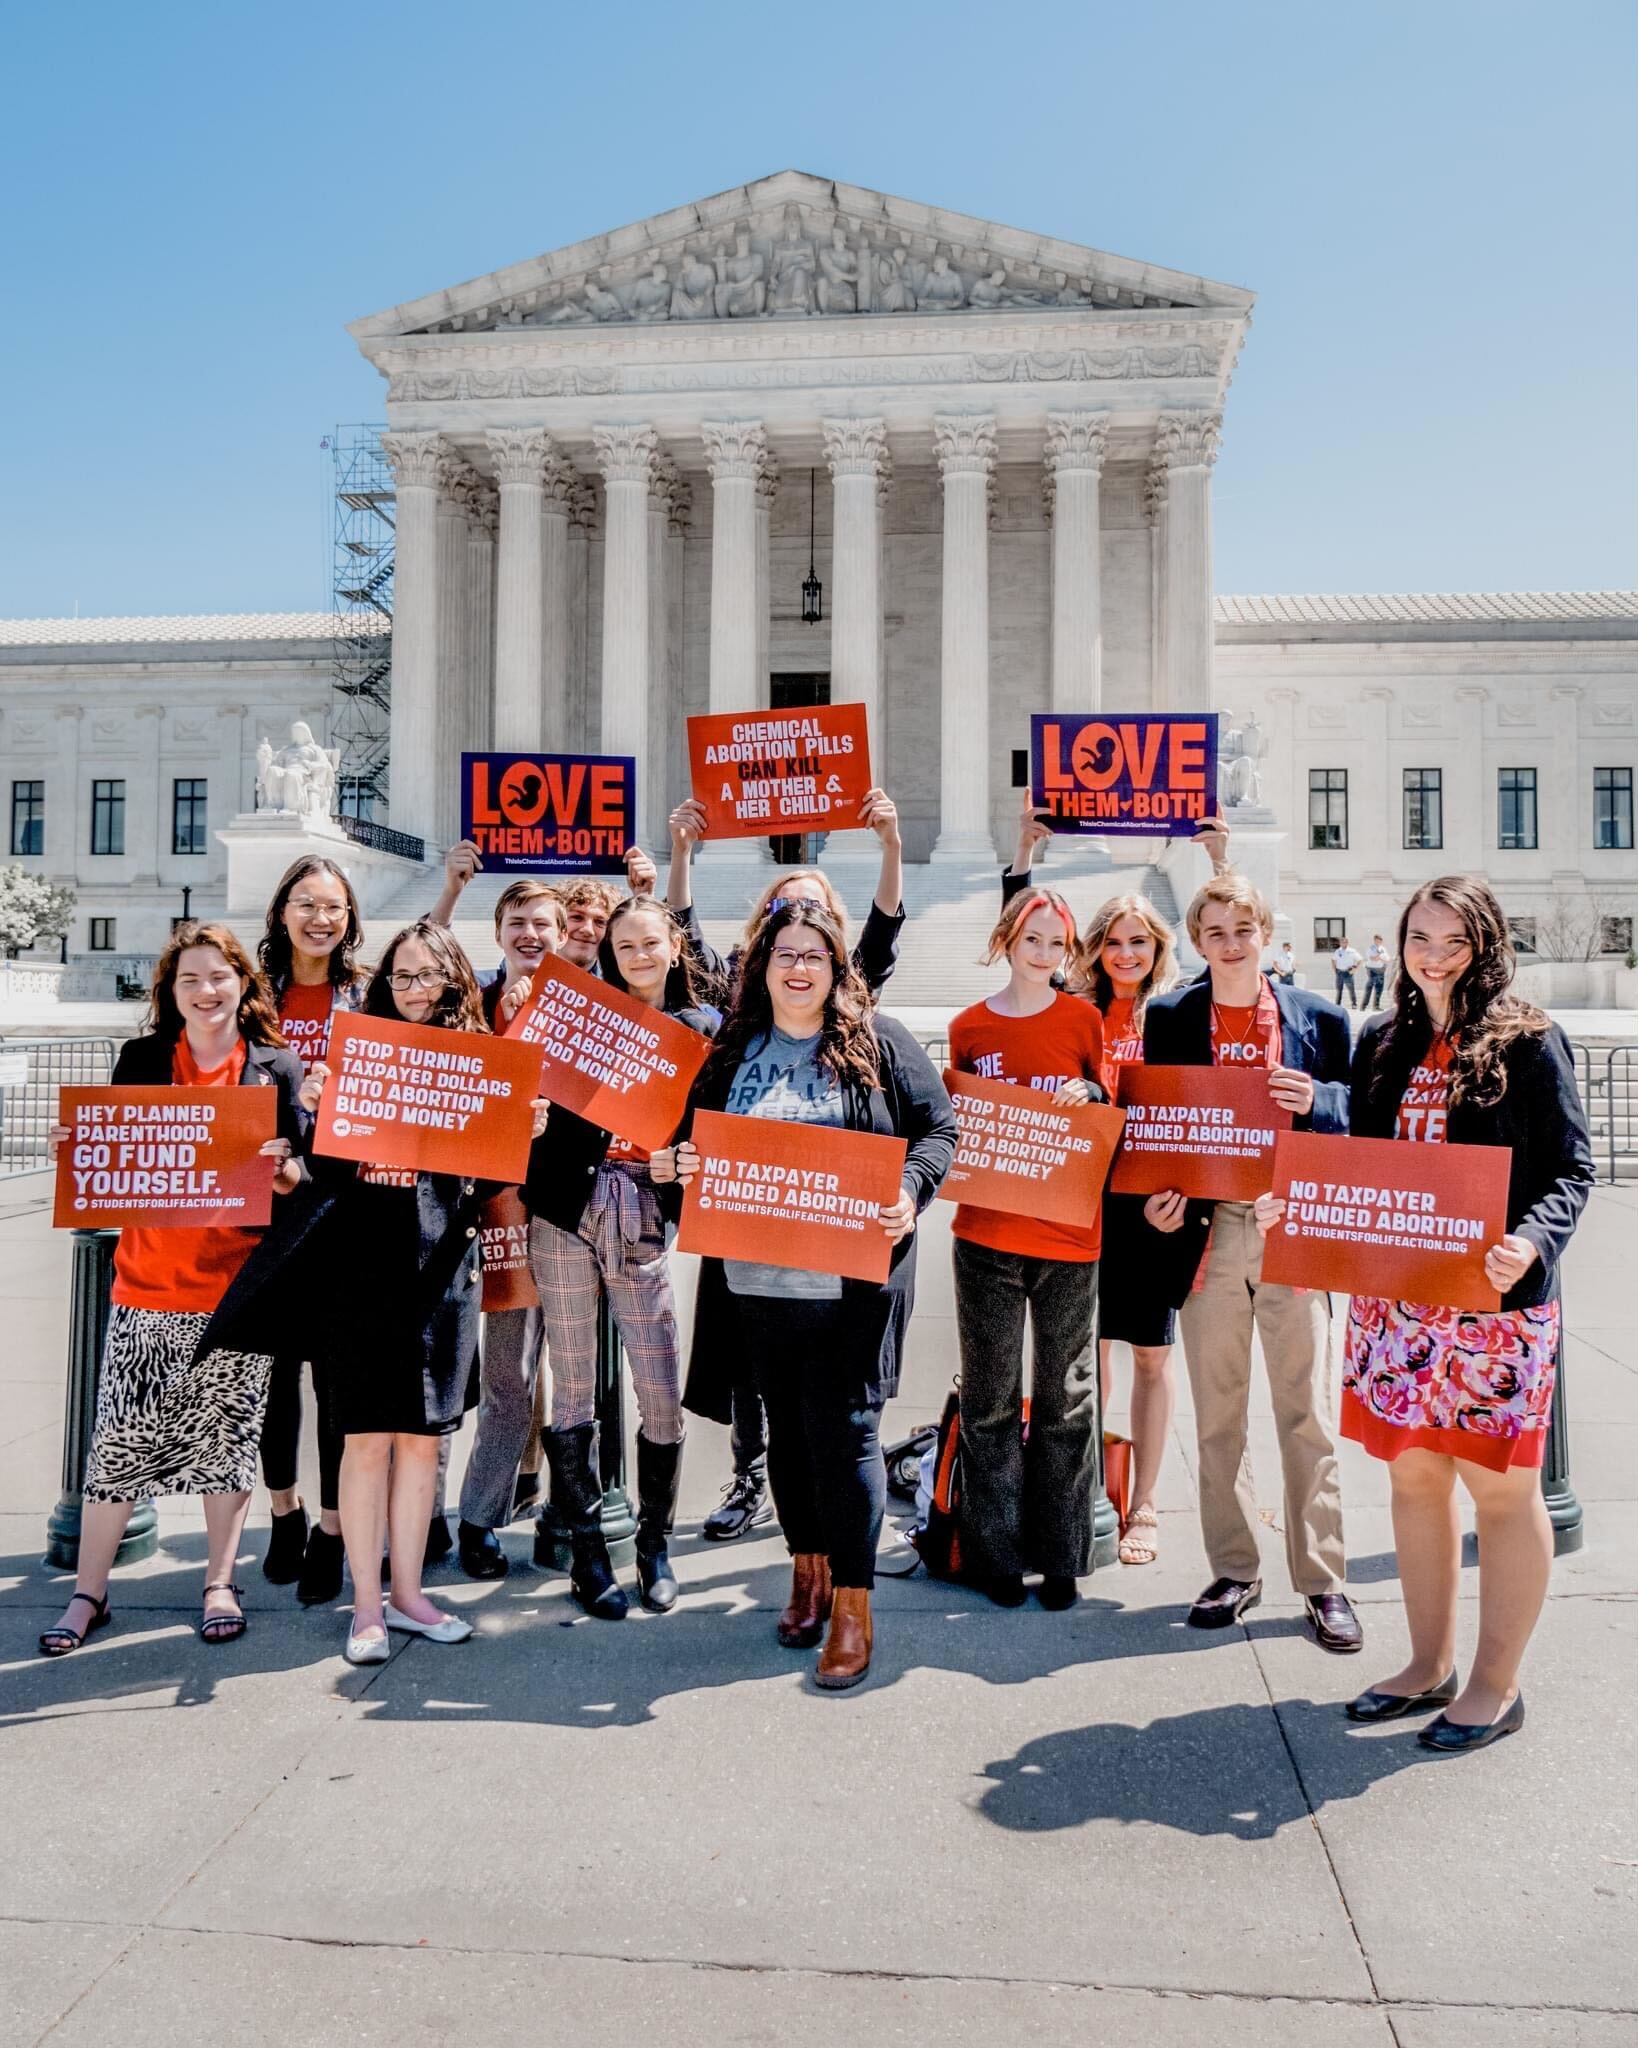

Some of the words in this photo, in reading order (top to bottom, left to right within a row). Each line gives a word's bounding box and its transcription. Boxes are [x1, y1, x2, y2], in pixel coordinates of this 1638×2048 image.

[732, 718, 822, 743] CHEMICAL
[705, 739, 797, 765] ABORTION
[805, 735, 854, 756] PILLS
[1043, 722, 1207, 791] LOVE
[738, 759, 777, 781] CAN
[786, 756, 822, 776] KILL
[472, 761, 625, 827] LOVE
[721, 783, 734, 801] A
[742, 776, 816, 800] MOTHER
[825, 774, 845, 793] &
[736, 799, 771, 819] HER
[779, 794, 831, 816] CHILD
[1044, 791, 1119, 818] THEM
[1133, 792, 1206, 819] BOTH
[472, 828, 544, 855] THEM
[557, 828, 625, 856] BOTH
[544, 978, 588, 1009] STOP
[590, 1001, 661, 1049] TURNING
[528, 1009, 569, 1039] INTO
[568, 1030, 652, 1084] ABORTION
[537, 994, 614, 1046] TAXPAYER
[615, 1036, 678, 1078] DOLLARS
[344, 1037, 394, 1061] STOP
[399, 1046, 484, 1074] TURNING
[342, 1057, 433, 1087] TAXPAYER
[437, 1073, 513, 1097] DOLLARS
[575, 1054, 636, 1094] MONEY
[338, 1076, 383, 1098] INTO
[387, 1084, 485, 1114] ABORTION
[76, 1105, 117, 1123] HEY
[124, 1105, 216, 1123] PLANNED
[335, 1095, 398, 1121] BLOOD
[401, 1107, 471, 1131] MONEY
[951, 1093, 995, 1115] STOP
[999, 1104, 1072, 1132] TURNING
[1127, 1105, 1146, 1121] NO
[1149, 1105, 1235, 1125] TAXPAYER
[76, 1125, 213, 1145] PARENTHOOD,
[955, 1112, 1026, 1140] AXPAYER
[1028, 1129, 1093, 1154] DOLLARS
[1125, 1124, 1184, 1141] FUNDED
[1187, 1125, 1275, 1146] ABORTION
[73, 1145, 111, 1168] GO
[119, 1144, 196, 1168] FUND
[983, 1134, 1068, 1166] ABORTION
[1135, 1142, 1262, 1158] STUDENTSFORLIFEACTION.ORG
[73, 1170, 222, 1195] YOURSELF.
[704, 1157, 731, 1177] NO
[736, 1161, 840, 1193] TAXPAYER
[993, 1157, 1054, 1181] MONEY
[91, 1197, 246, 1209] STUDENTSFORLIFEACTION.ORG
[701, 1177, 779, 1203] FUNDED
[784, 1188, 881, 1220] ABORTION
[1289, 1180, 1319, 1202] NO
[1323, 1184, 1437, 1213] TAXPAYER
[714, 1200, 865, 1231] STUDENTSFORLIFEACTION.ORG
[1286, 1201, 1371, 1228] FUNDED
[1375, 1211, 1485, 1241] ABORTION
[1301, 1225, 1468, 1254] STUDENTSFORLIFEACTION.ORG
